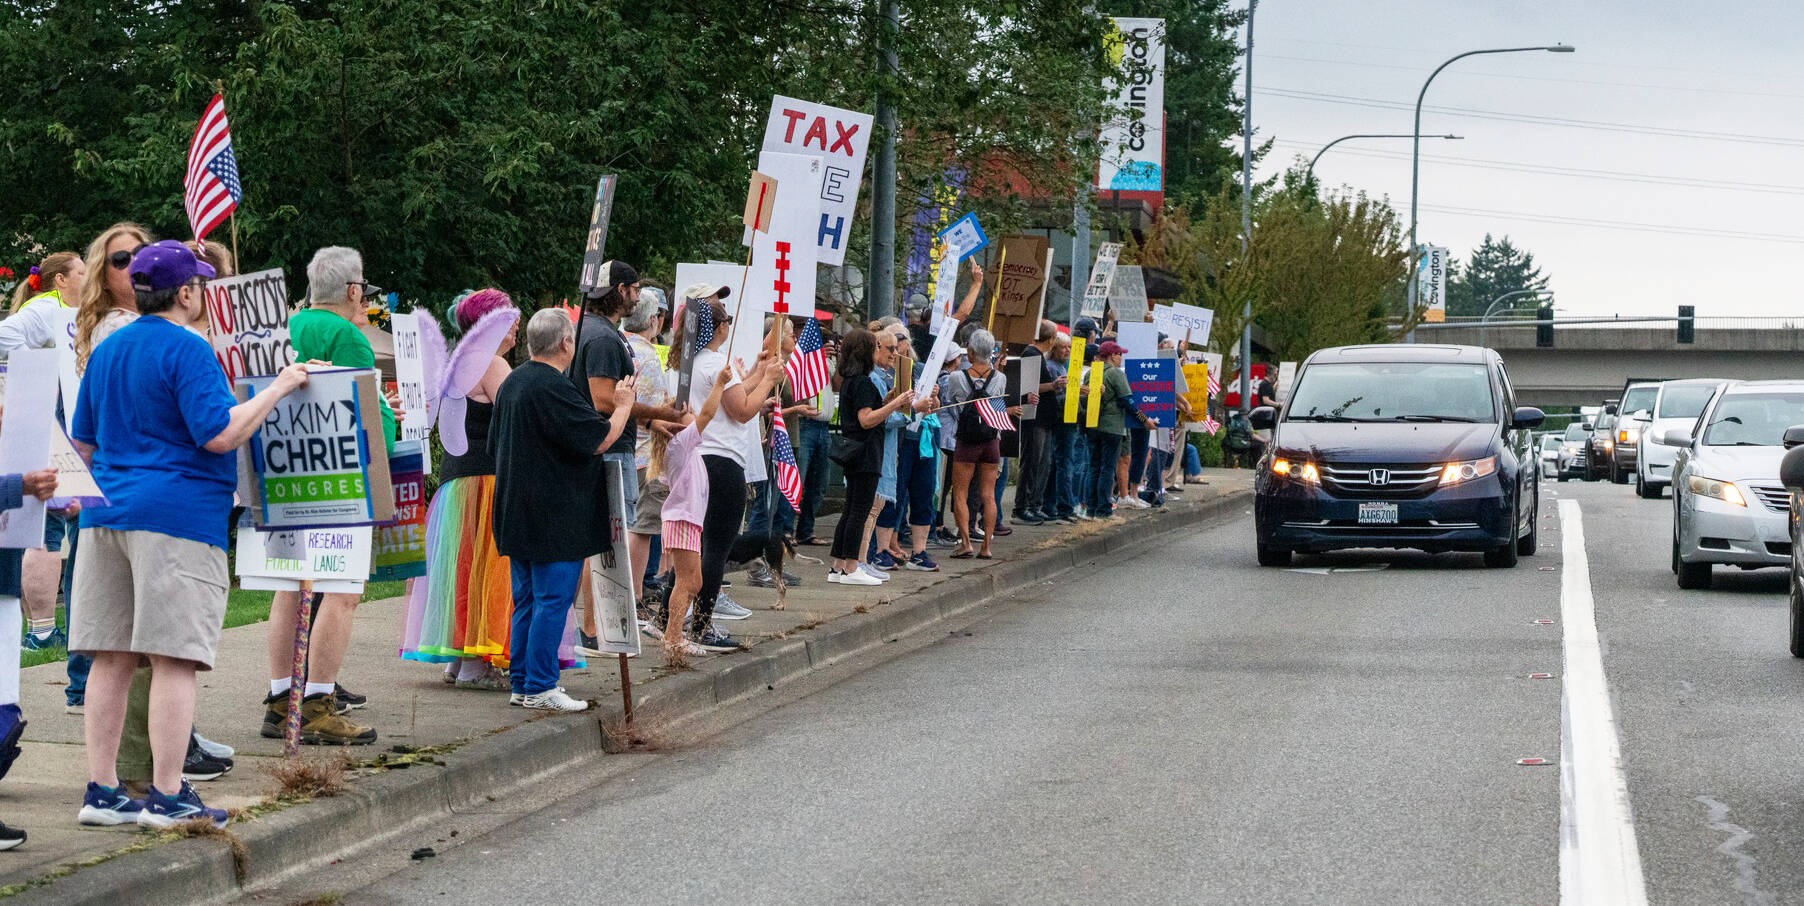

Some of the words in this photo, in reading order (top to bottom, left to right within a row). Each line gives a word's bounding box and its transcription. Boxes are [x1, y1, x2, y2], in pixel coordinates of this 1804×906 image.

[782, 108, 859, 157] TAX
[204, 285, 233, 336] NO
[397, 331, 418, 359] FIGHT
[259, 406, 288, 437] R.
[288, 401, 339, 436] KIM
[265, 436, 359, 474] CHRIE
[266, 479, 364, 498] ONGRES
[392, 482, 419, 503] TED
[308, 532, 353, 549] RESEARCH
[313, 555, 346, 572] LANDS
